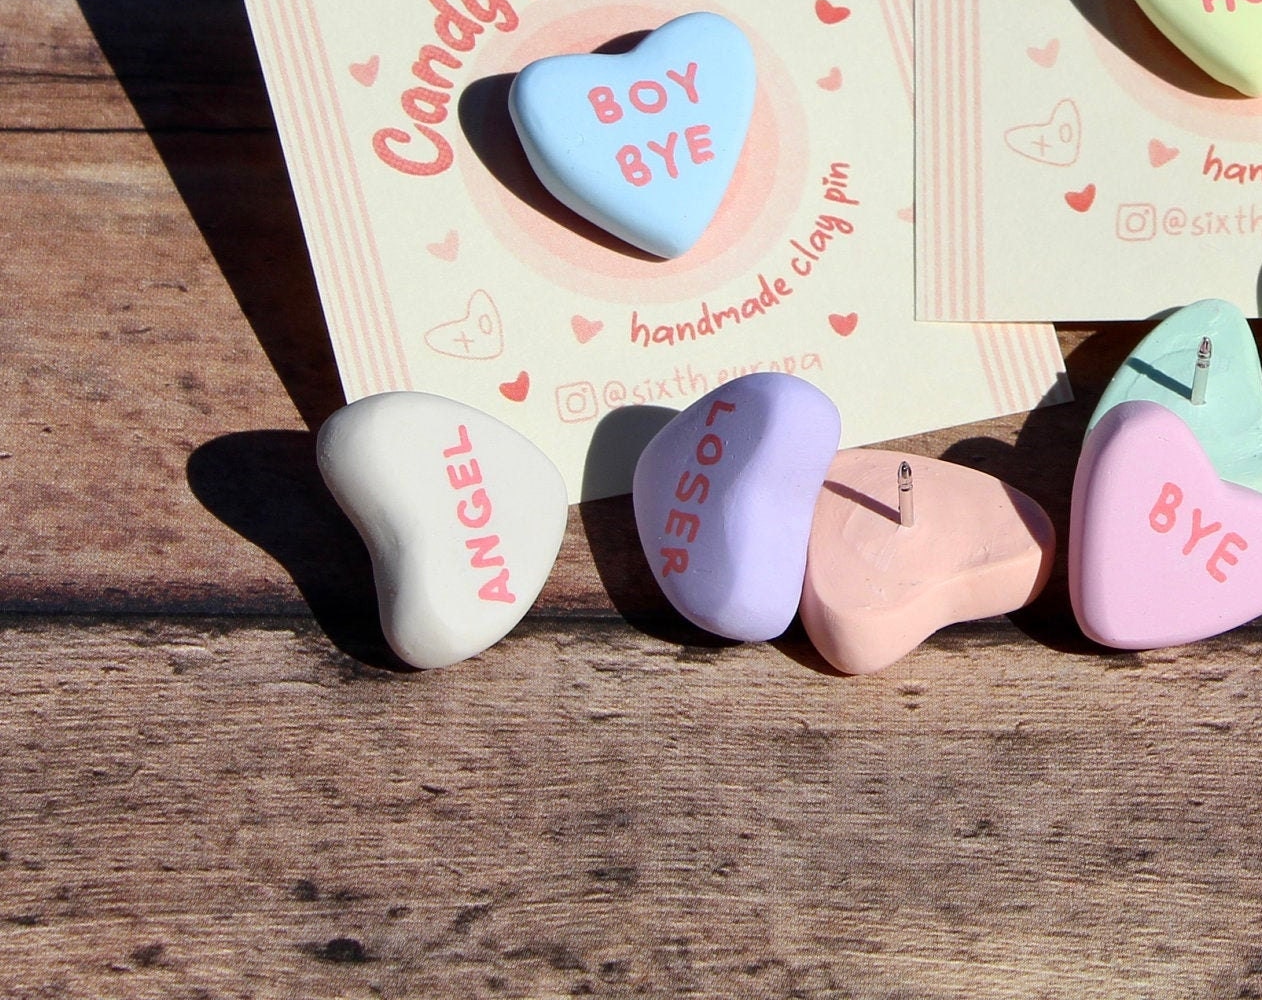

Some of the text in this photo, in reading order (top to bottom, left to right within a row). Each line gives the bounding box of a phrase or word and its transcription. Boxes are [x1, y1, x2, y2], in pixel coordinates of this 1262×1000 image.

[587, 62, 699, 124] BOY
[615, 124, 716, 187] BYE
[630, 161, 860, 348] handmade clay pin
[443, 424, 516, 604] ANGEL
[660, 399, 736, 578] LOSER
[1148, 481, 1249, 584] BYE
